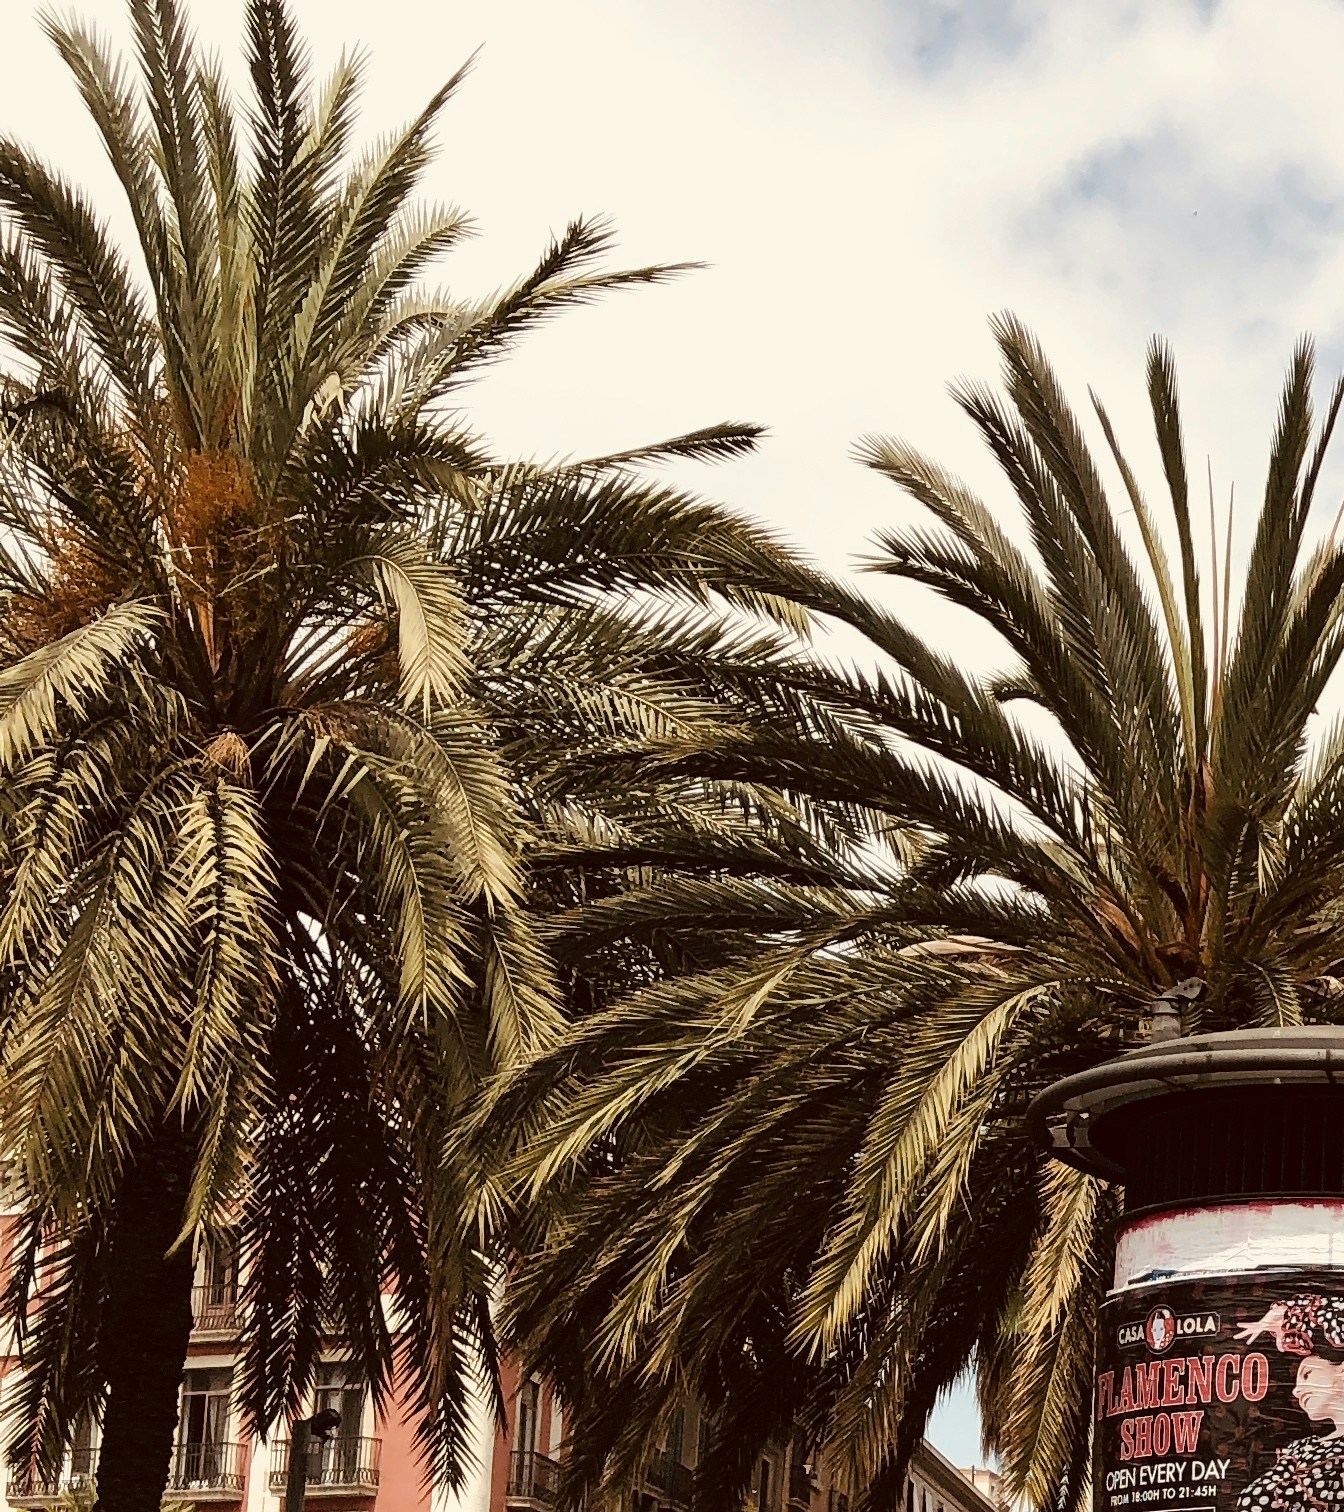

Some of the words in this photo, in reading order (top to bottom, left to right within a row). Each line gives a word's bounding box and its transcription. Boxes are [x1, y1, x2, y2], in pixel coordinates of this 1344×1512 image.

[1119, 1325, 1144, 1344] CASA
[1177, 1316, 1216, 1335] LOLA
[1097, 1352, 1269, 1421] FLAMENCO
[1120, 1410, 1204, 1460] SHOW
[1106, 1467, 1136, 1491] OPEN
[1139, 1462, 1187, 1486] EVERY
[1191, 1459, 1231, 1481] DAY
[1110, 1495, 1129, 1506] FROM
[1162, 1488, 1175, 1500] TO
[1179, 1485, 1217, 1498] 21:45H
